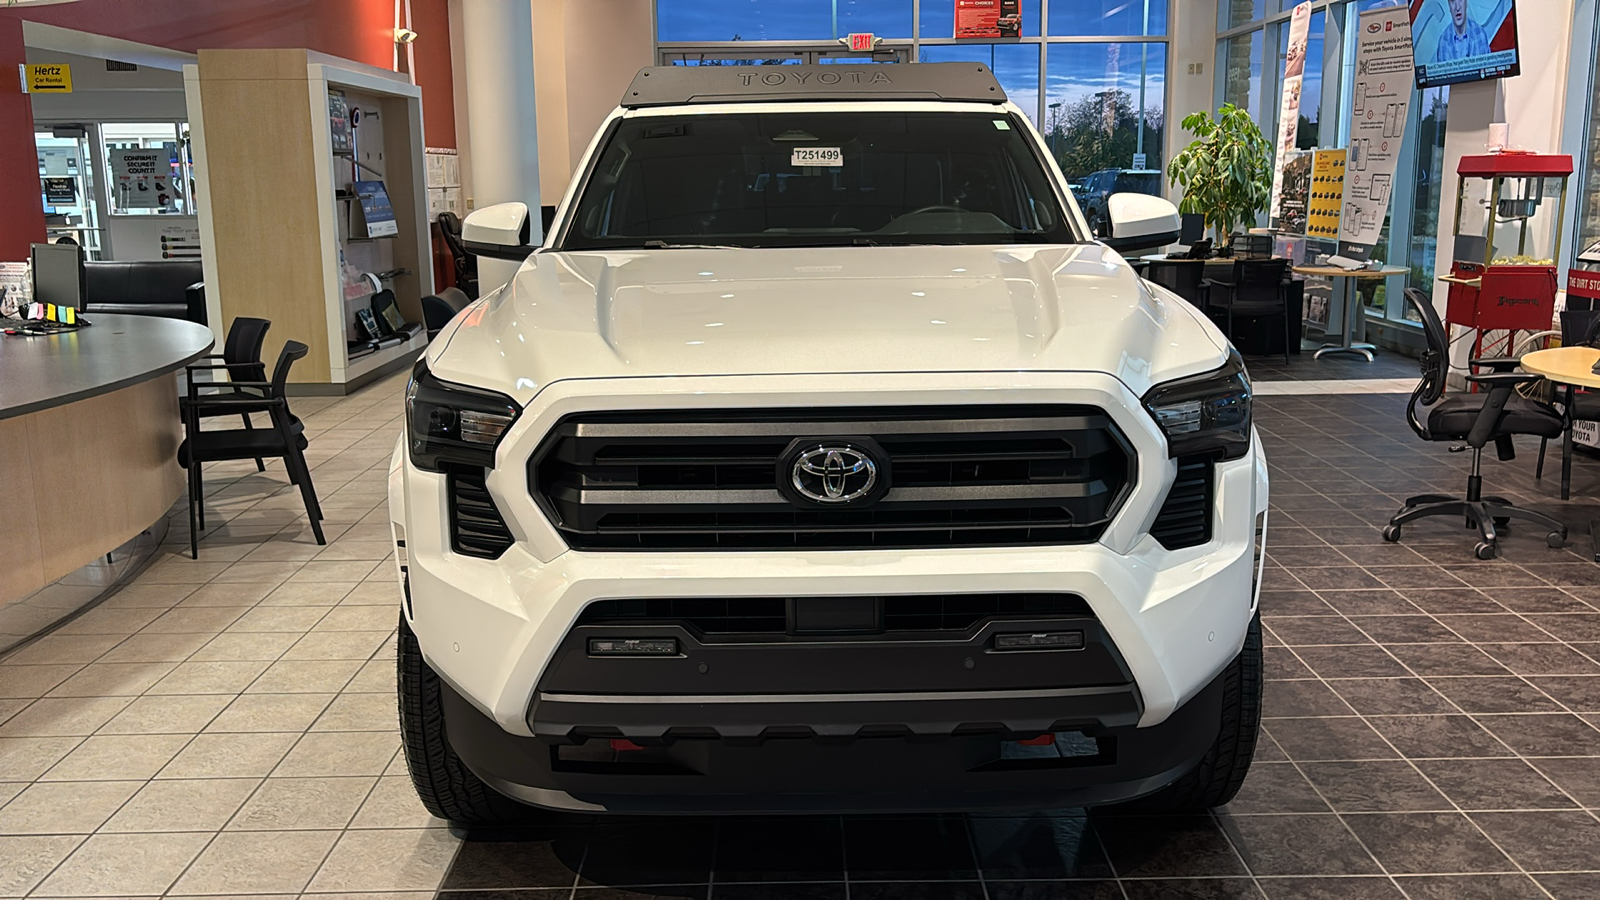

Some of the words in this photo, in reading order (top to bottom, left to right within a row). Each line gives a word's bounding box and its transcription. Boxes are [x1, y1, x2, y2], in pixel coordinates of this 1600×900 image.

[852, 34, 872, 50] EXIT
[34, 66, 61, 75] Hertz
[737, 70, 894, 87] TOYOTA
[795, 150, 839, 160] T251499
[1577, 278, 1588, 289] DIRT
[1497, 296, 1539, 307] Popcorn
[1579, 420, 1595, 432] YOUR
[1572, 430, 1591, 442] OYOTA
